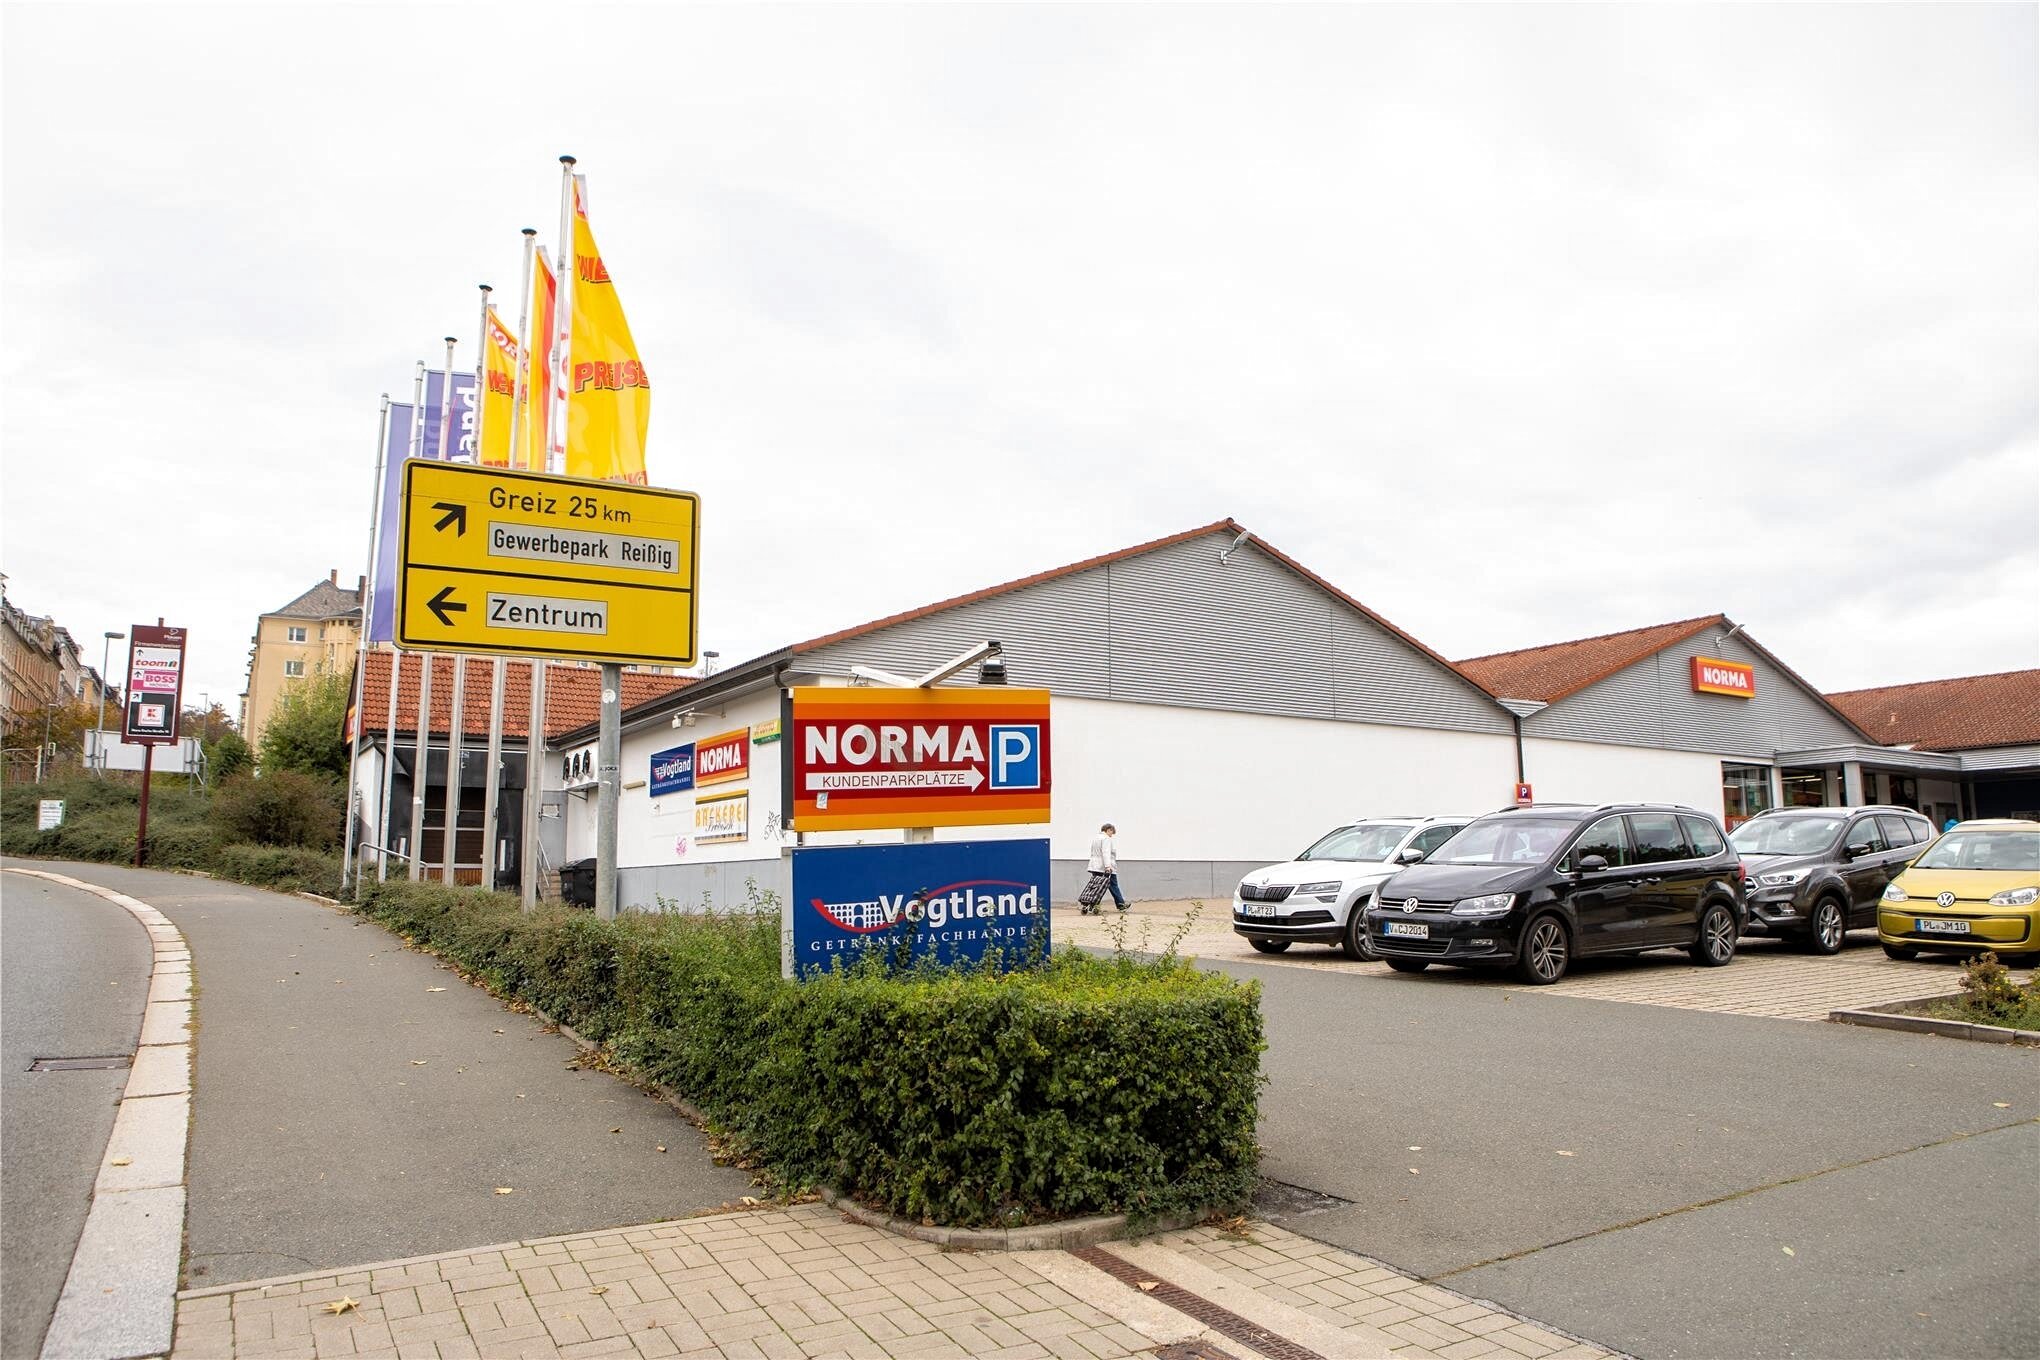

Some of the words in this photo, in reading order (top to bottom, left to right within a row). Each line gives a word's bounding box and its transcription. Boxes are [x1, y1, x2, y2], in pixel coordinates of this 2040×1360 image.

[489, 487, 557, 515] Greiz
[569, 495, 597, 518] 25
[603, 504, 631, 523] km
[494, 528, 609, 560] Gewerbepark
[621, 541, 672, 569] Reißig
[491, 598, 603, 628] Zentrum
[135, 659, 168, 667] toom
[1703, 666, 1748, 689] NORMA
[145, 675, 176, 684] BOSS
[700, 742, 741, 774] NORMA
[805, 724, 985, 766] NORMA
[998, 731, 1031, 783] P
[662, 755, 691, 778] Vogtland
[822, 771, 965, 788] KUNDENPARKPLÄTZE
[879, 885, 1038, 928] Vogtland
